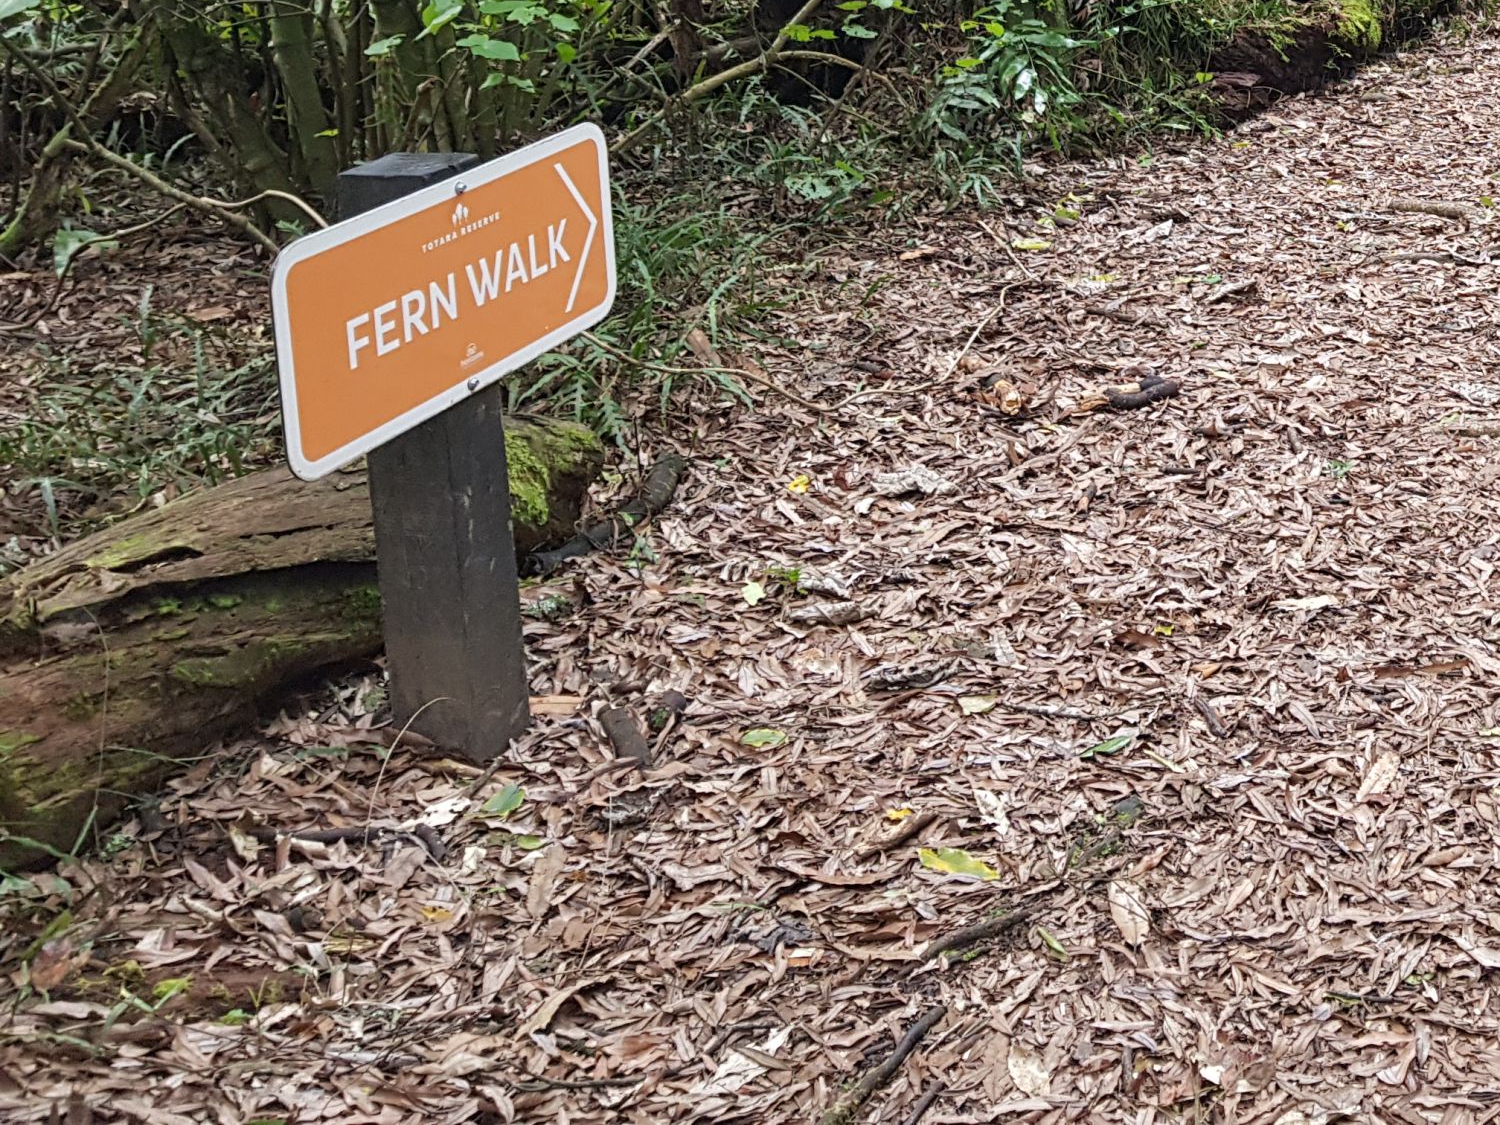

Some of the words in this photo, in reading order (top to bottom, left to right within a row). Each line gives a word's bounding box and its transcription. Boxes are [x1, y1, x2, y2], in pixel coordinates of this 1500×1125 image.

[421, 231, 458, 254] TOTARA
[460, 211, 500, 236] RESERVE
[345, 273, 458, 370] FERN
[464, 218, 572, 308] WALK
